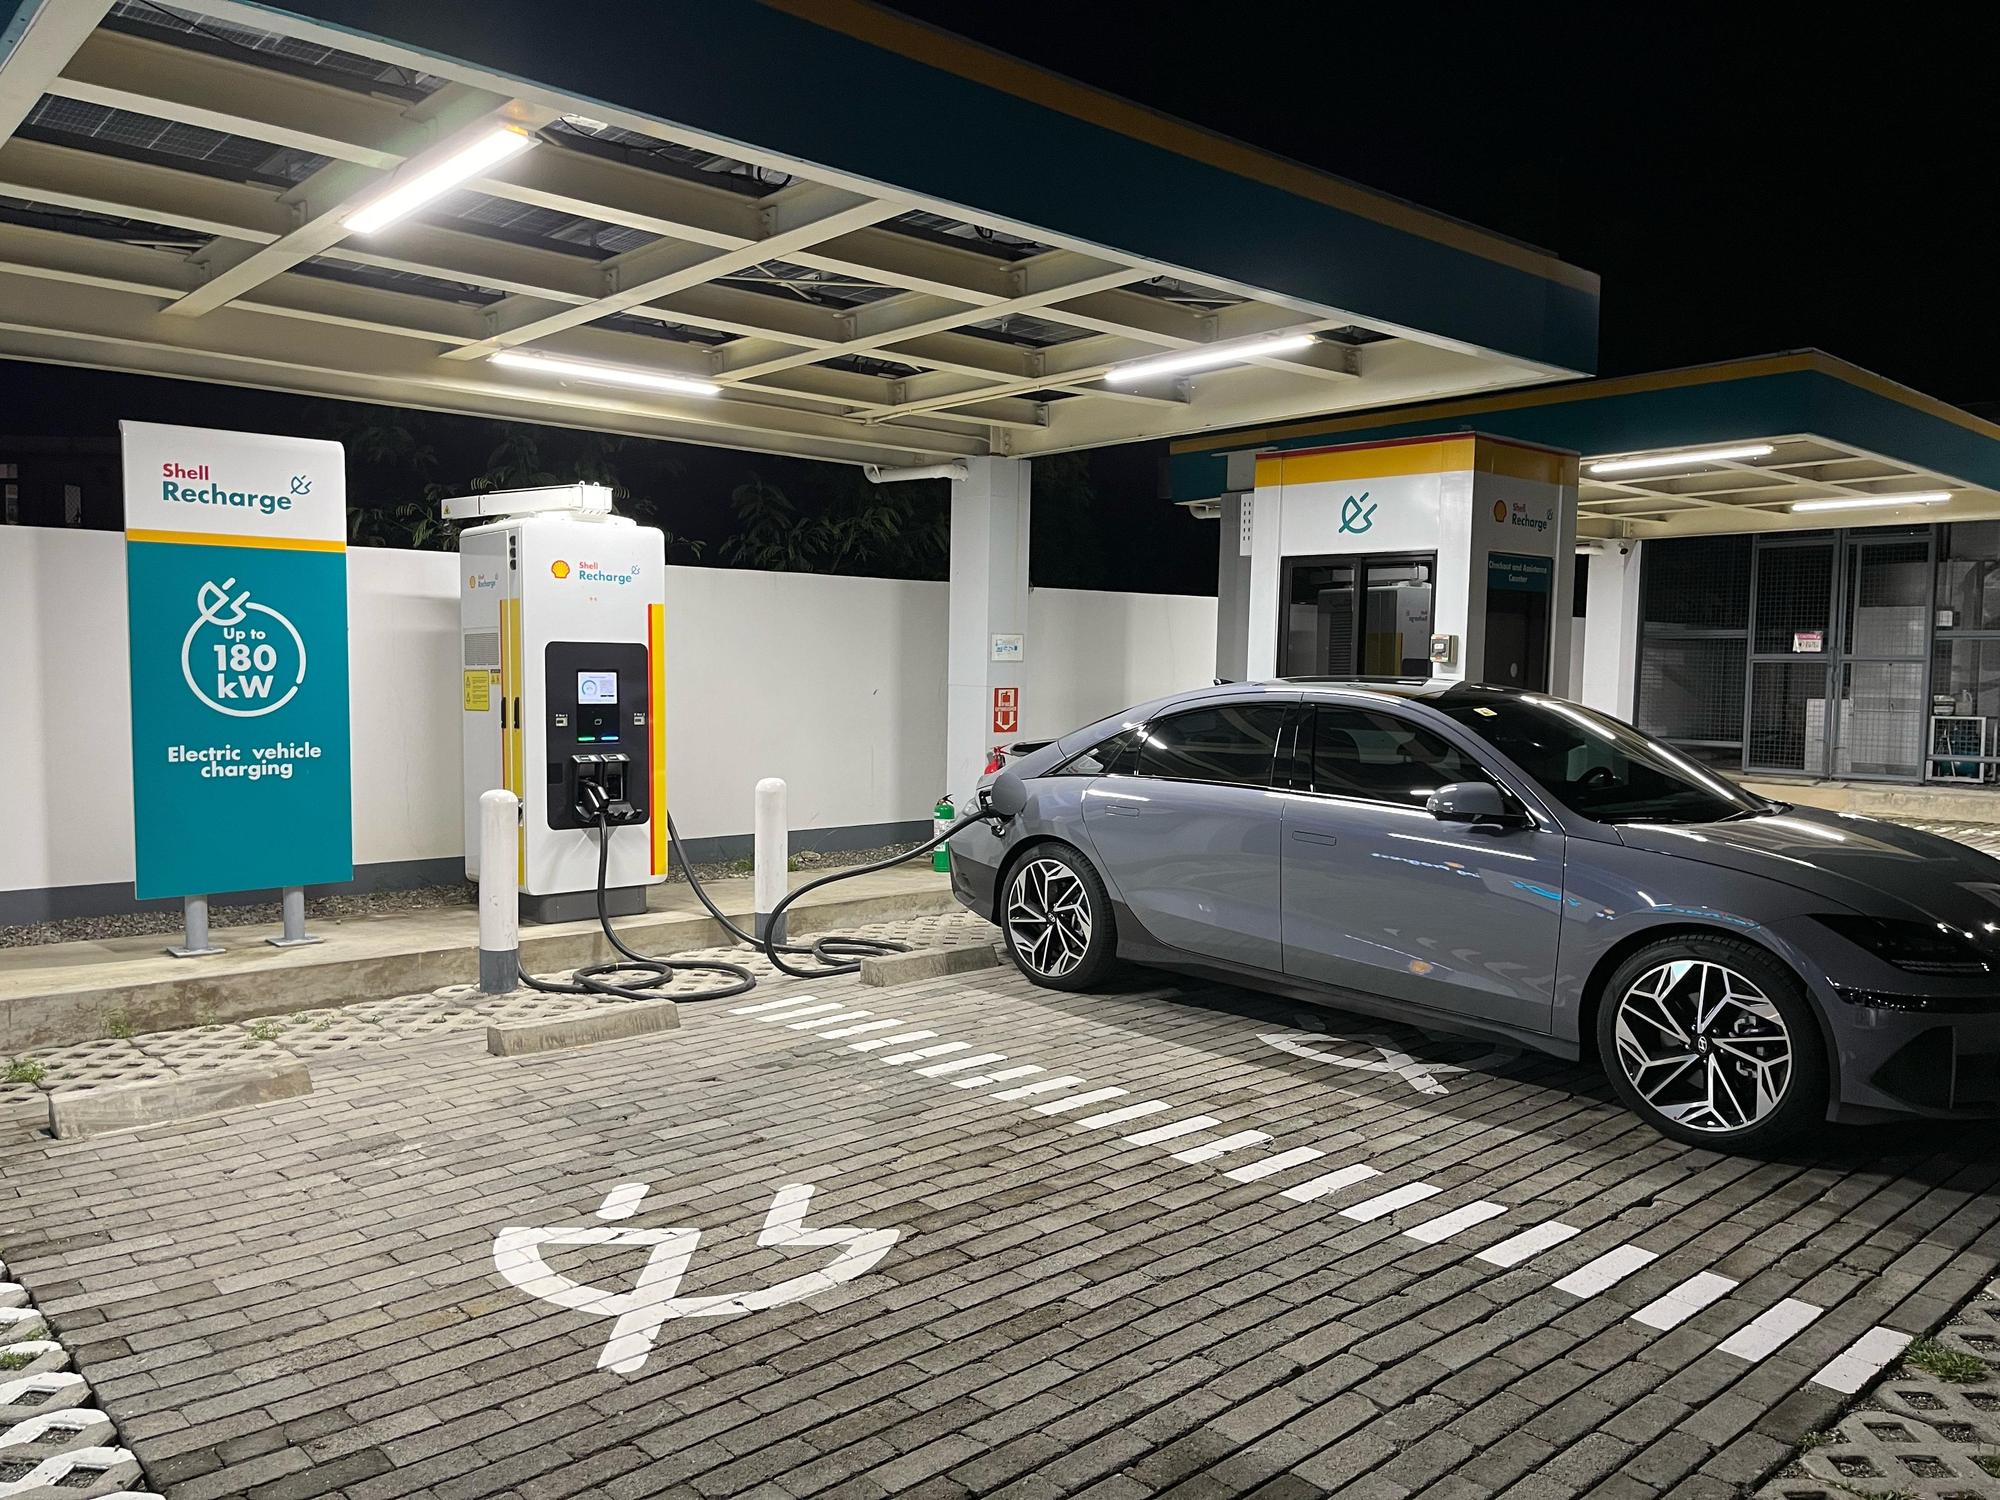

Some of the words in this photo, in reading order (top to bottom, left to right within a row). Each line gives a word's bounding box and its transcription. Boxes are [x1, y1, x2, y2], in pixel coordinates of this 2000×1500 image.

[163, 463, 209, 480] Shell
[162, 481, 292, 514] Recharge
[1512, 513, 1547, 532] Recharge
[579, 561, 598, 569] Shell
[579, 570, 632, 585] Recharge
[223, 627, 246, 642] Up
[250, 629, 266, 640] to
[213, 644, 277, 672] 180
[217, 673, 274, 699] kW
[168, 744, 241, 763] Electric
[252, 742, 322, 760] vehicle
[201, 760, 293, 780] charging
